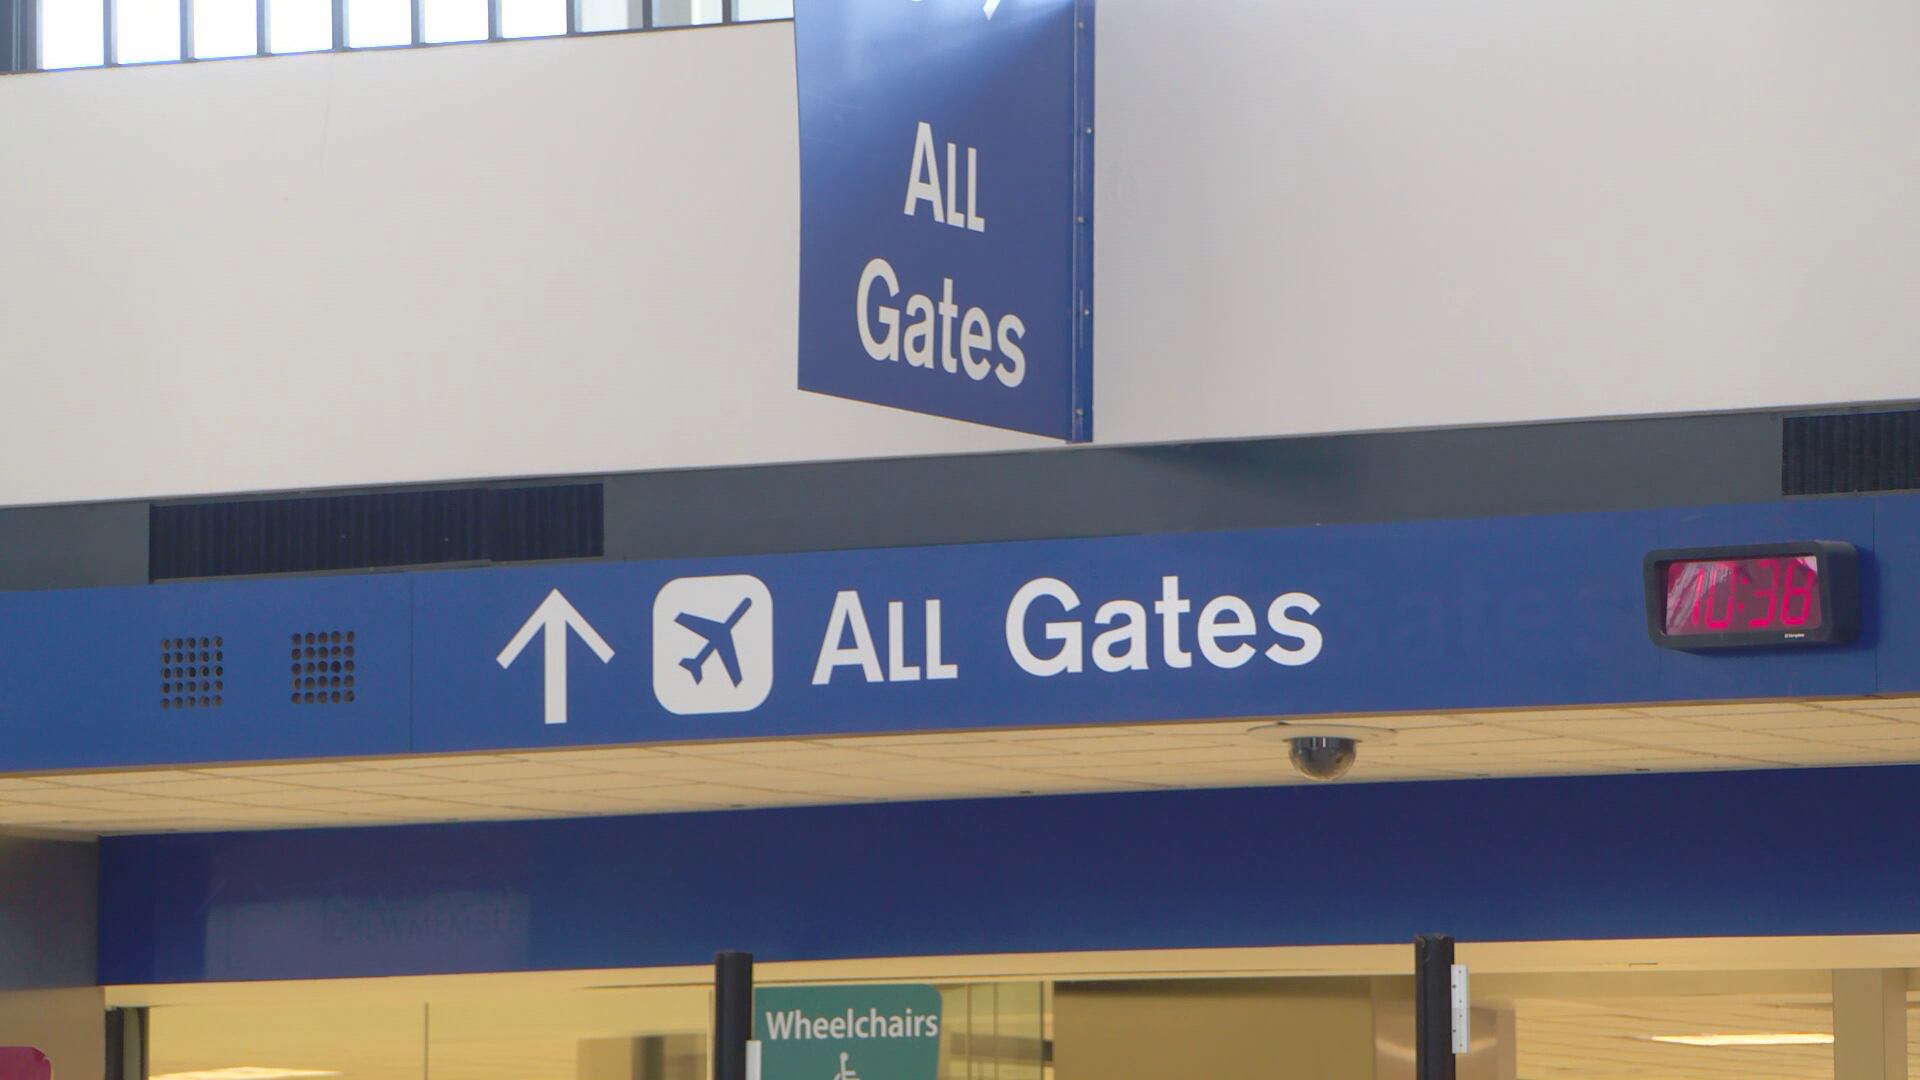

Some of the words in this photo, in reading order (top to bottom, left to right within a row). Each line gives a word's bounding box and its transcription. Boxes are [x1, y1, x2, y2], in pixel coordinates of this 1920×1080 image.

[903, 121, 985, 233] ALL
[856, 258, 1026, 388] Gates
[811, 590, 958, 685] ALL
[1005, 575, 1323, 677] Gates
[765, 1007, 939, 1040] Wheelchairs
